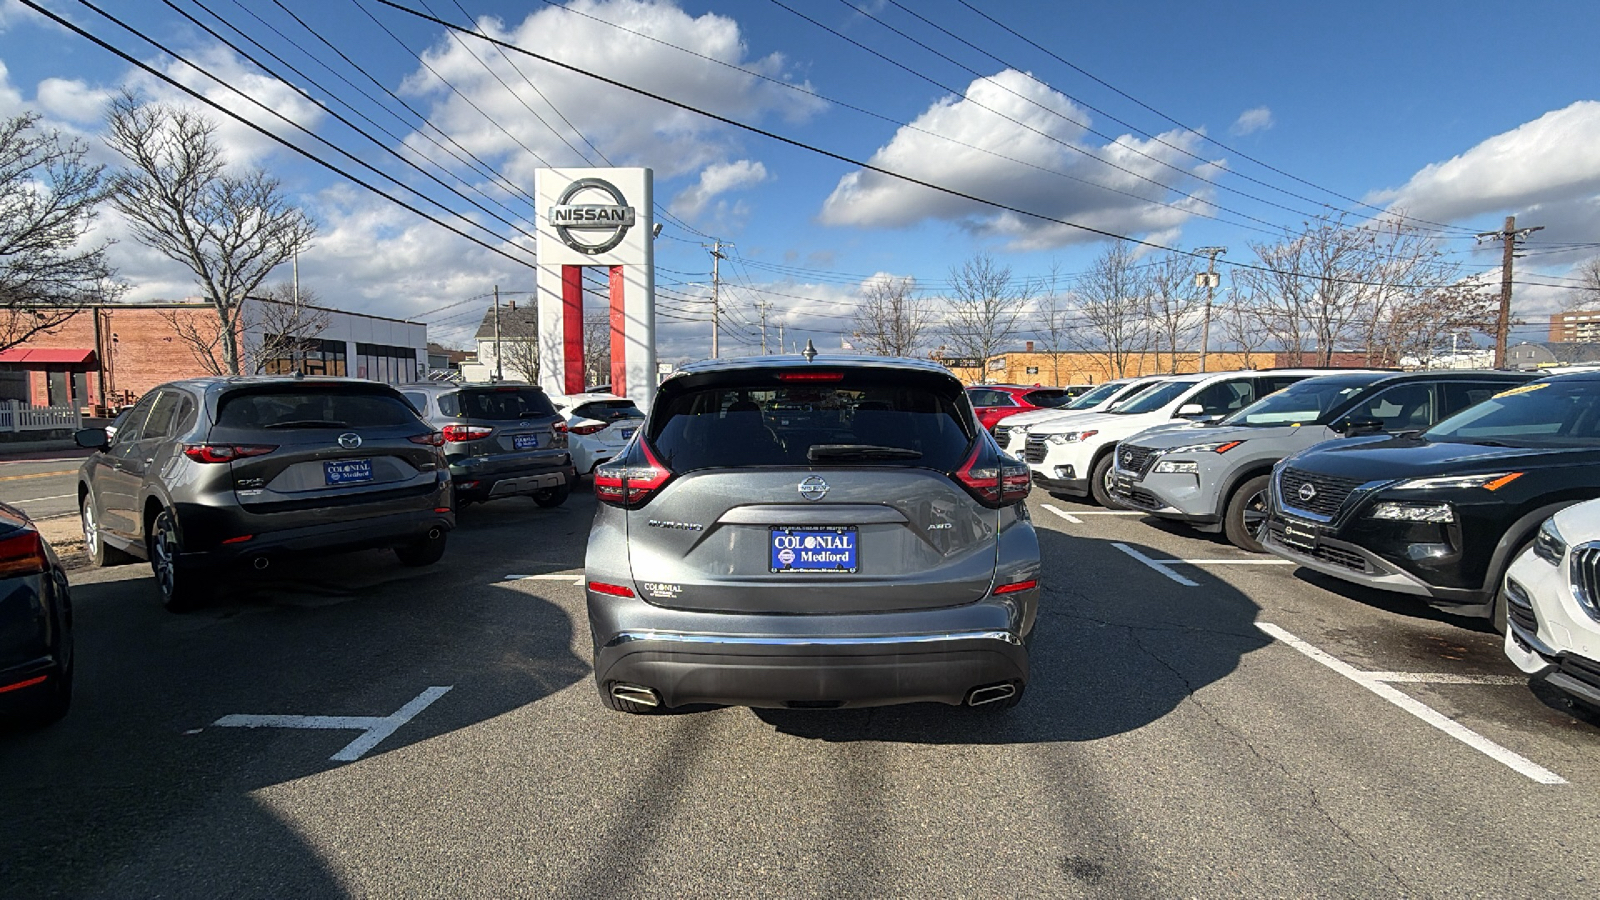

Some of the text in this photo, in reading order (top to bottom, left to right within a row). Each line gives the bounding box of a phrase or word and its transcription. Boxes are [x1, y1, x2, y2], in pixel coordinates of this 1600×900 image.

[555, 208, 625, 221] NISSAN
[327, 464, 370, 473] COLONIAL
[649, 519, 704, 531] MURANO
[927, 522, 953, 531] AWD
[774, 536, 852, 549] COLONIAL
[800, 551, 849, 562] Medford
[644, 582, 683, 593] COLONIAL
